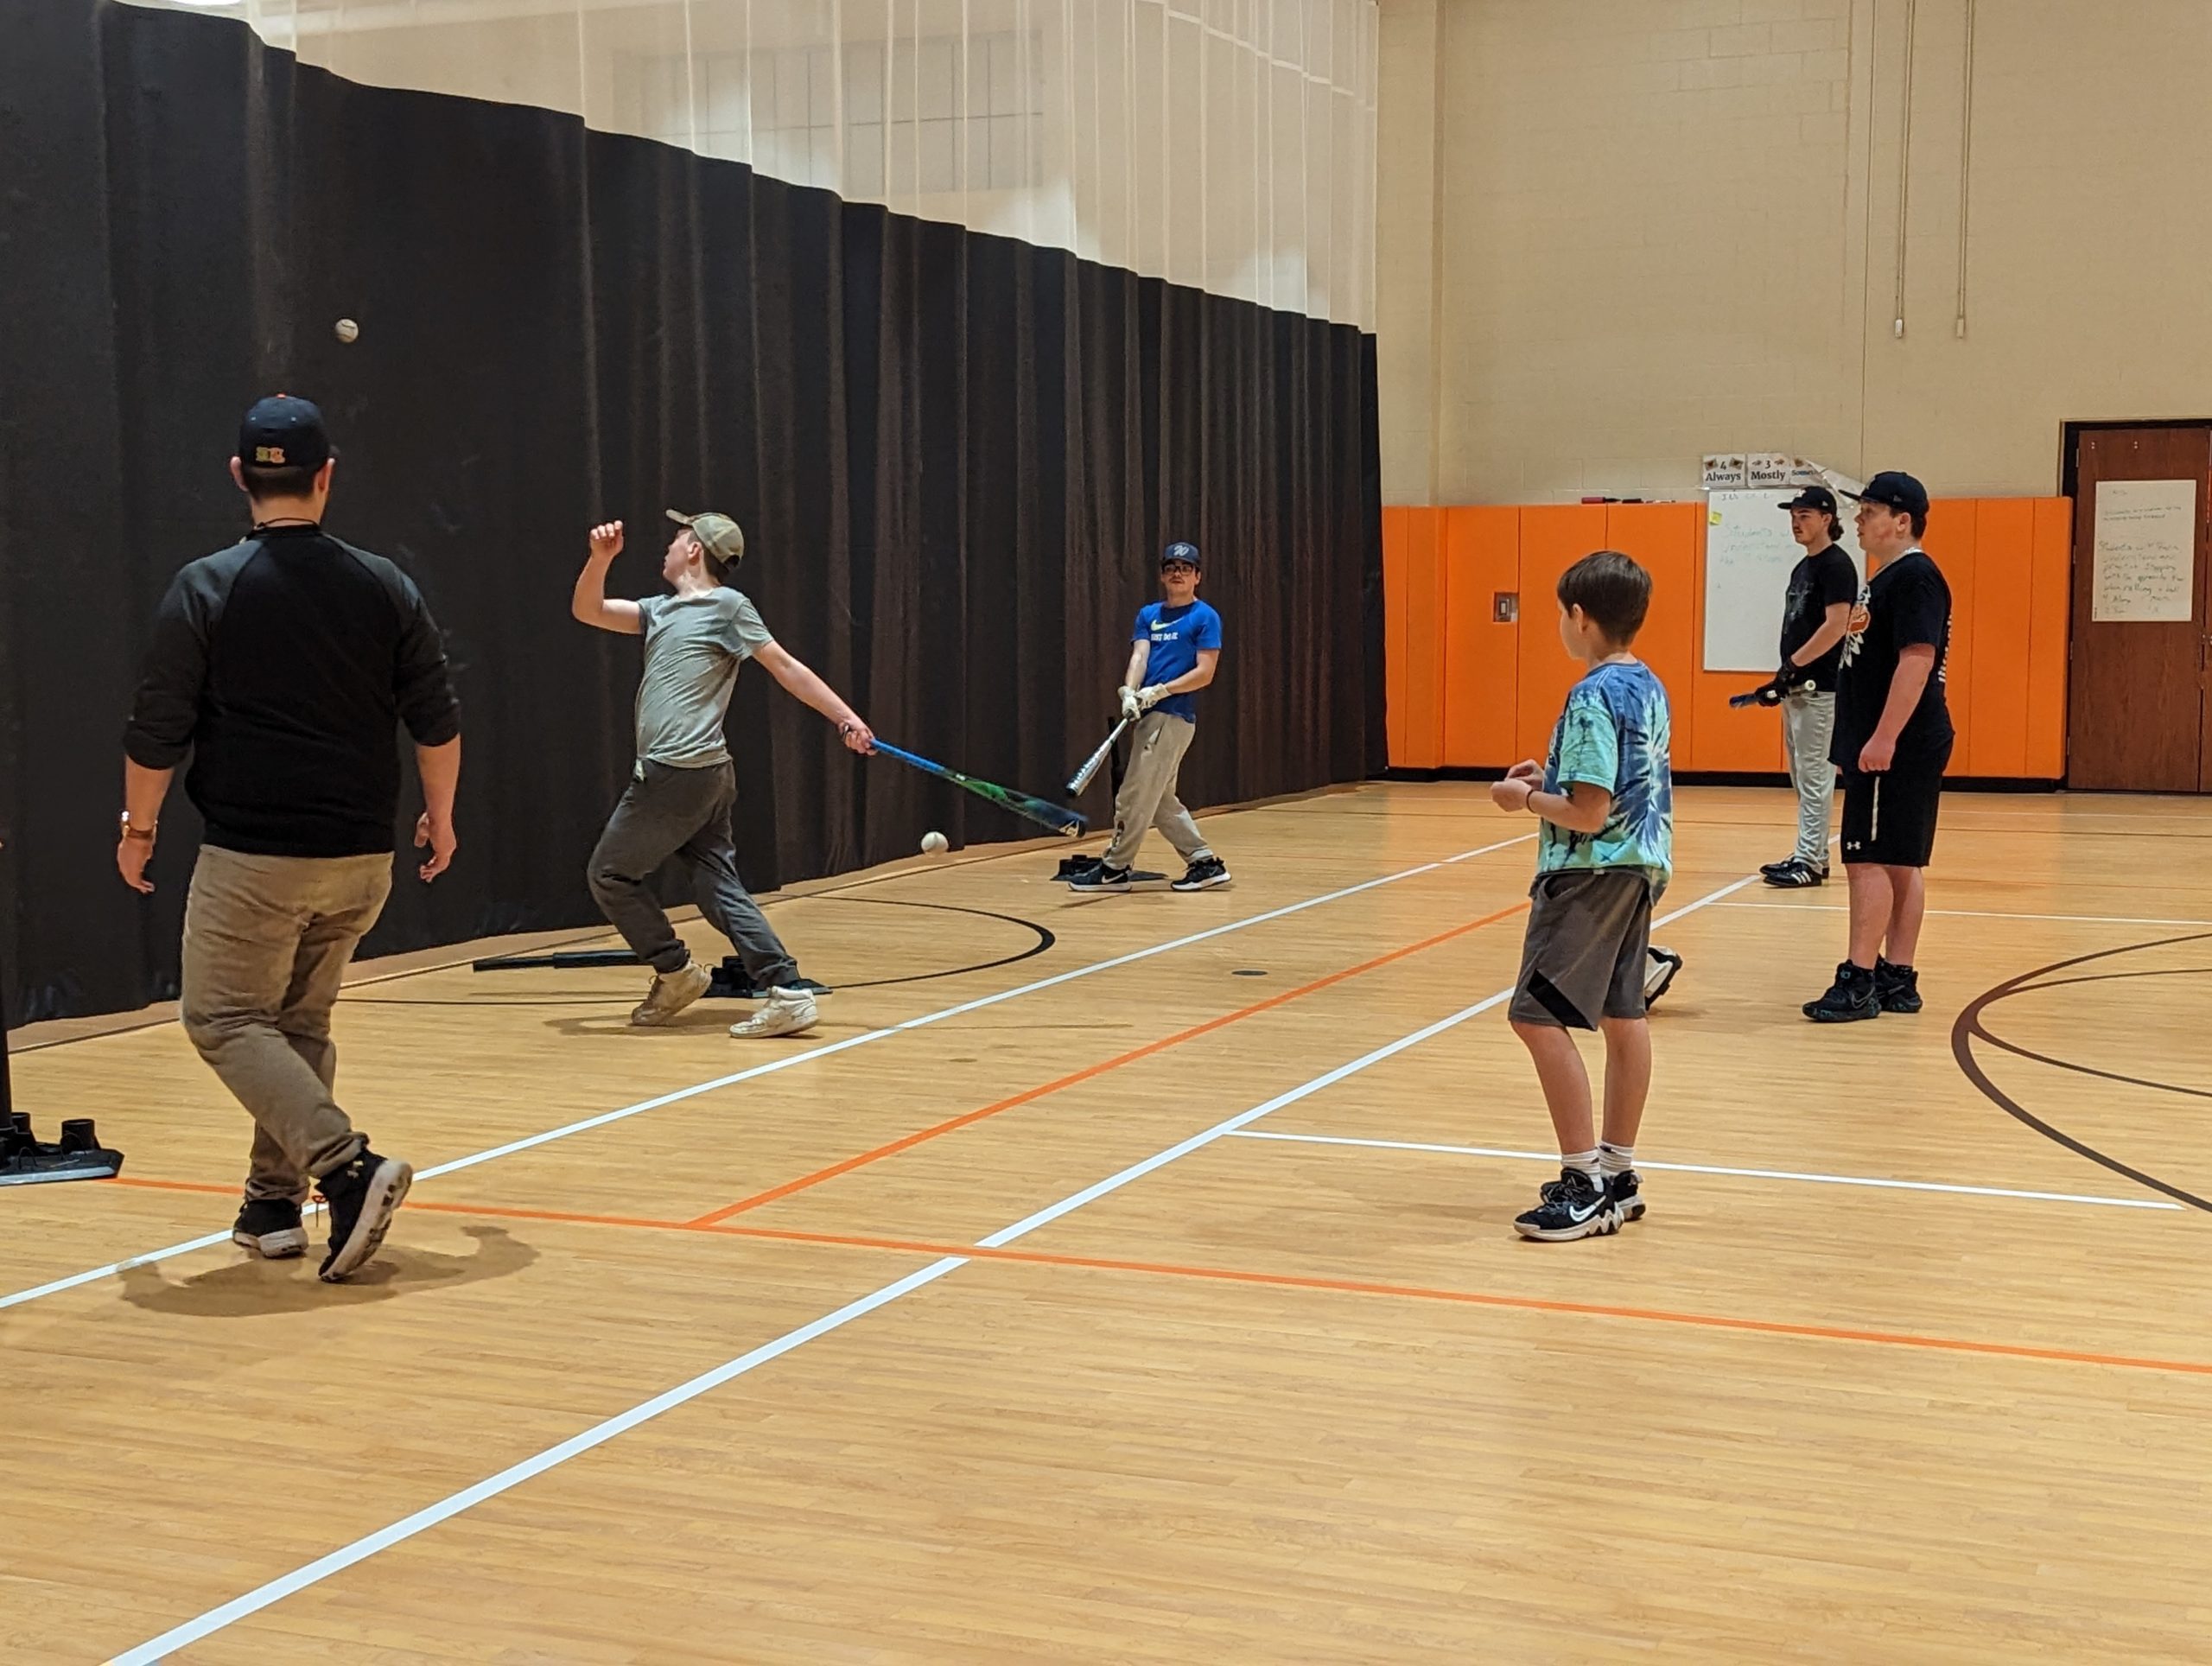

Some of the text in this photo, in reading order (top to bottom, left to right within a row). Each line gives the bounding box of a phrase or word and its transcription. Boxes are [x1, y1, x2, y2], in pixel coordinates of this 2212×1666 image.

[1720, 461, 1727, 470] 4
[1764, 460, 1771, 469] 3
[1706, 473, 1741, 481] Always
[1751, 469, 1786, 481] Mostly
